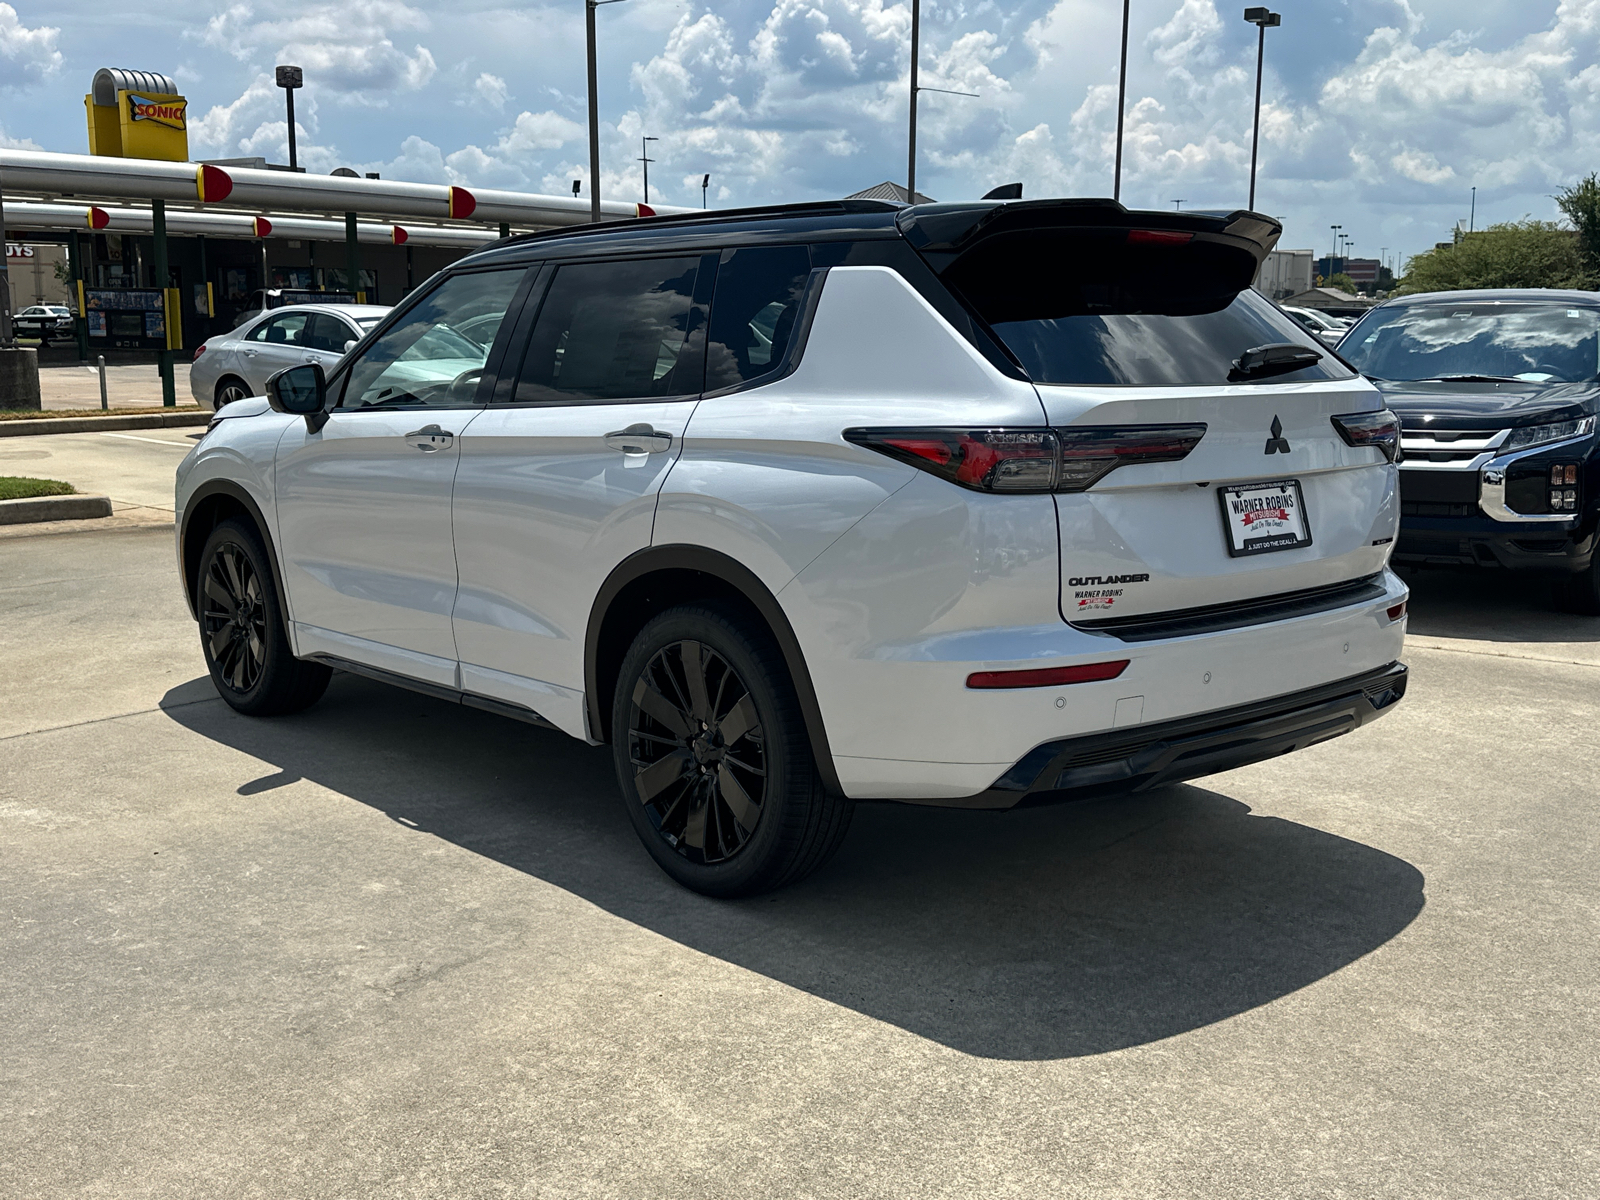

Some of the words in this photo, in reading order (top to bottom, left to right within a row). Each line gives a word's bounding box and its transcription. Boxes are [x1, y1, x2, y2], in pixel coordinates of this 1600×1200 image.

[137, 104, 182, 120] SONIC
[1231, 497, 1264, 514] WARNER
[1264, 494, 1294, 510] ROBINS
[1249, 508, 1281, 520] MITSUBISHI
[1252, 542, 1263, 550] JUST
[1068, 573, 1150, 586] OUTLANDER
[1074, 590, 1101, 599] WARNER
[1101, 589, 1123, 597] ROBINS
